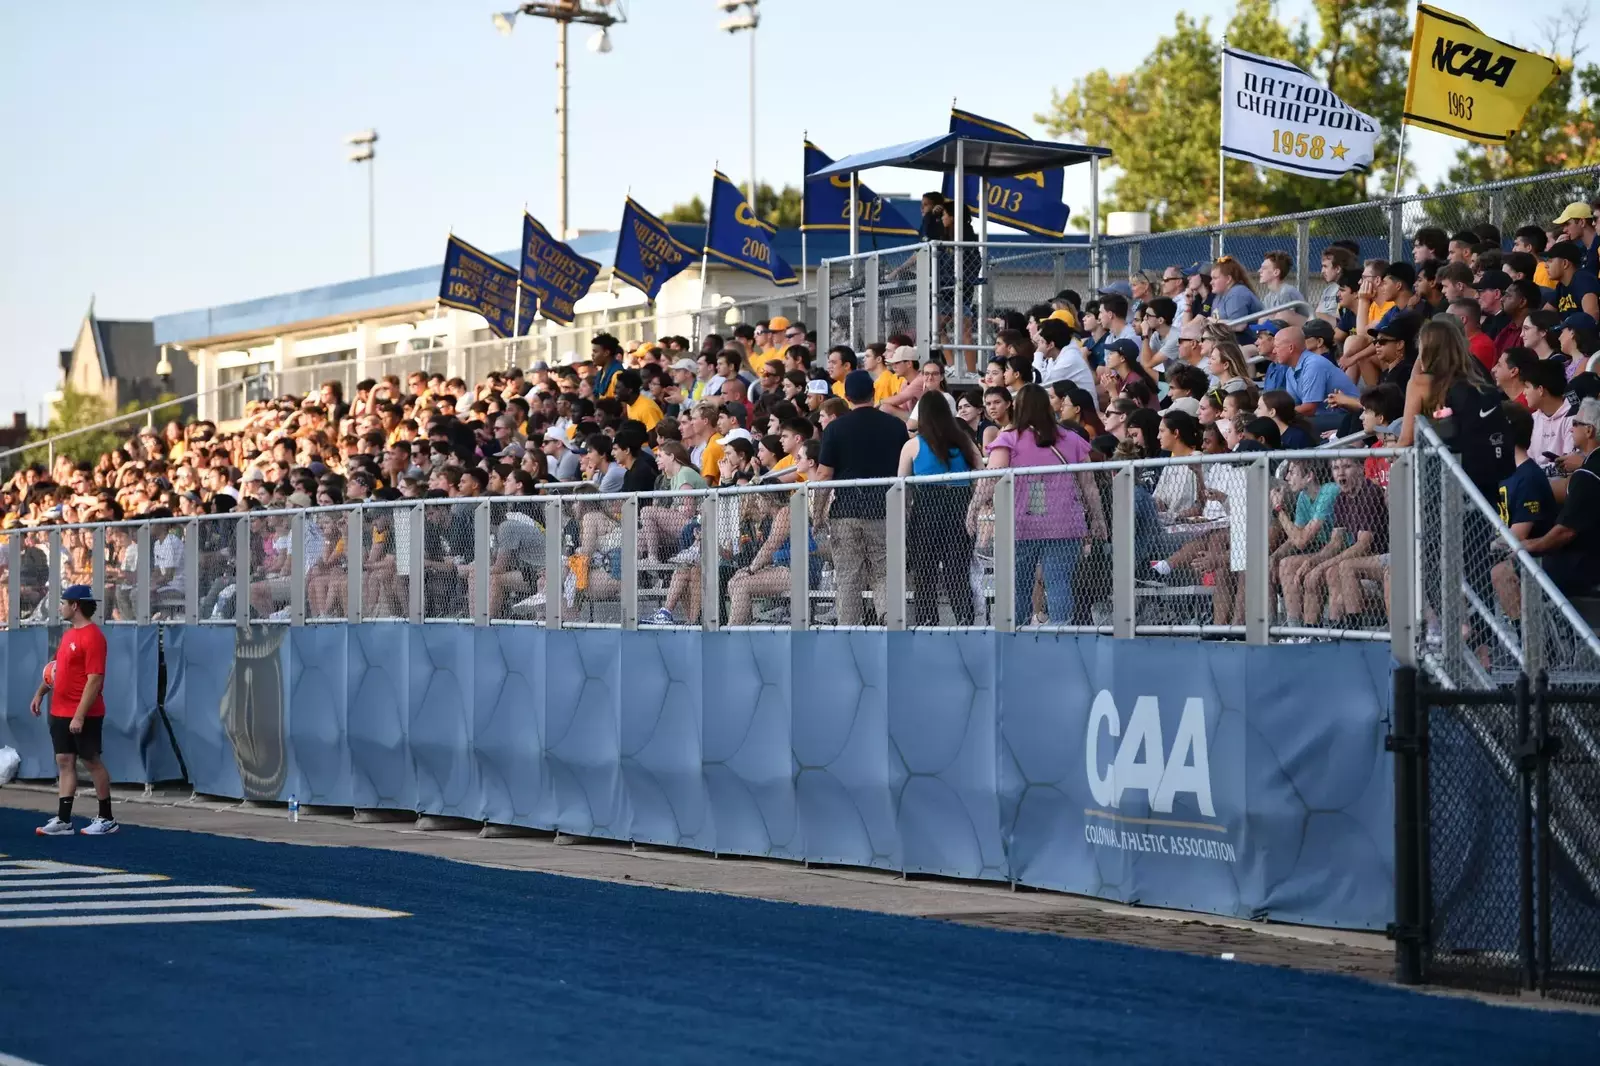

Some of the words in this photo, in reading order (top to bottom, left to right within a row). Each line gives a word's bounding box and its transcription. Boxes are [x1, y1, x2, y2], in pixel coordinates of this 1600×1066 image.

[1432, 37, 1517, 88] NCAA
[1243, 71, 1350, 110] NATION
[1447, 91, 1475, 121] 1963
[1237, 91, 1375, 133] CHAMPIONS
[1272, 129, 1326, 160] 1958
[742, 237, 770, 265] 2001
[1086, 689, 1216, 817] CAA
[1085, 824, 1121, 848] COLONIAL
[1170, 836, 1236, 863] ASSOCIATION
